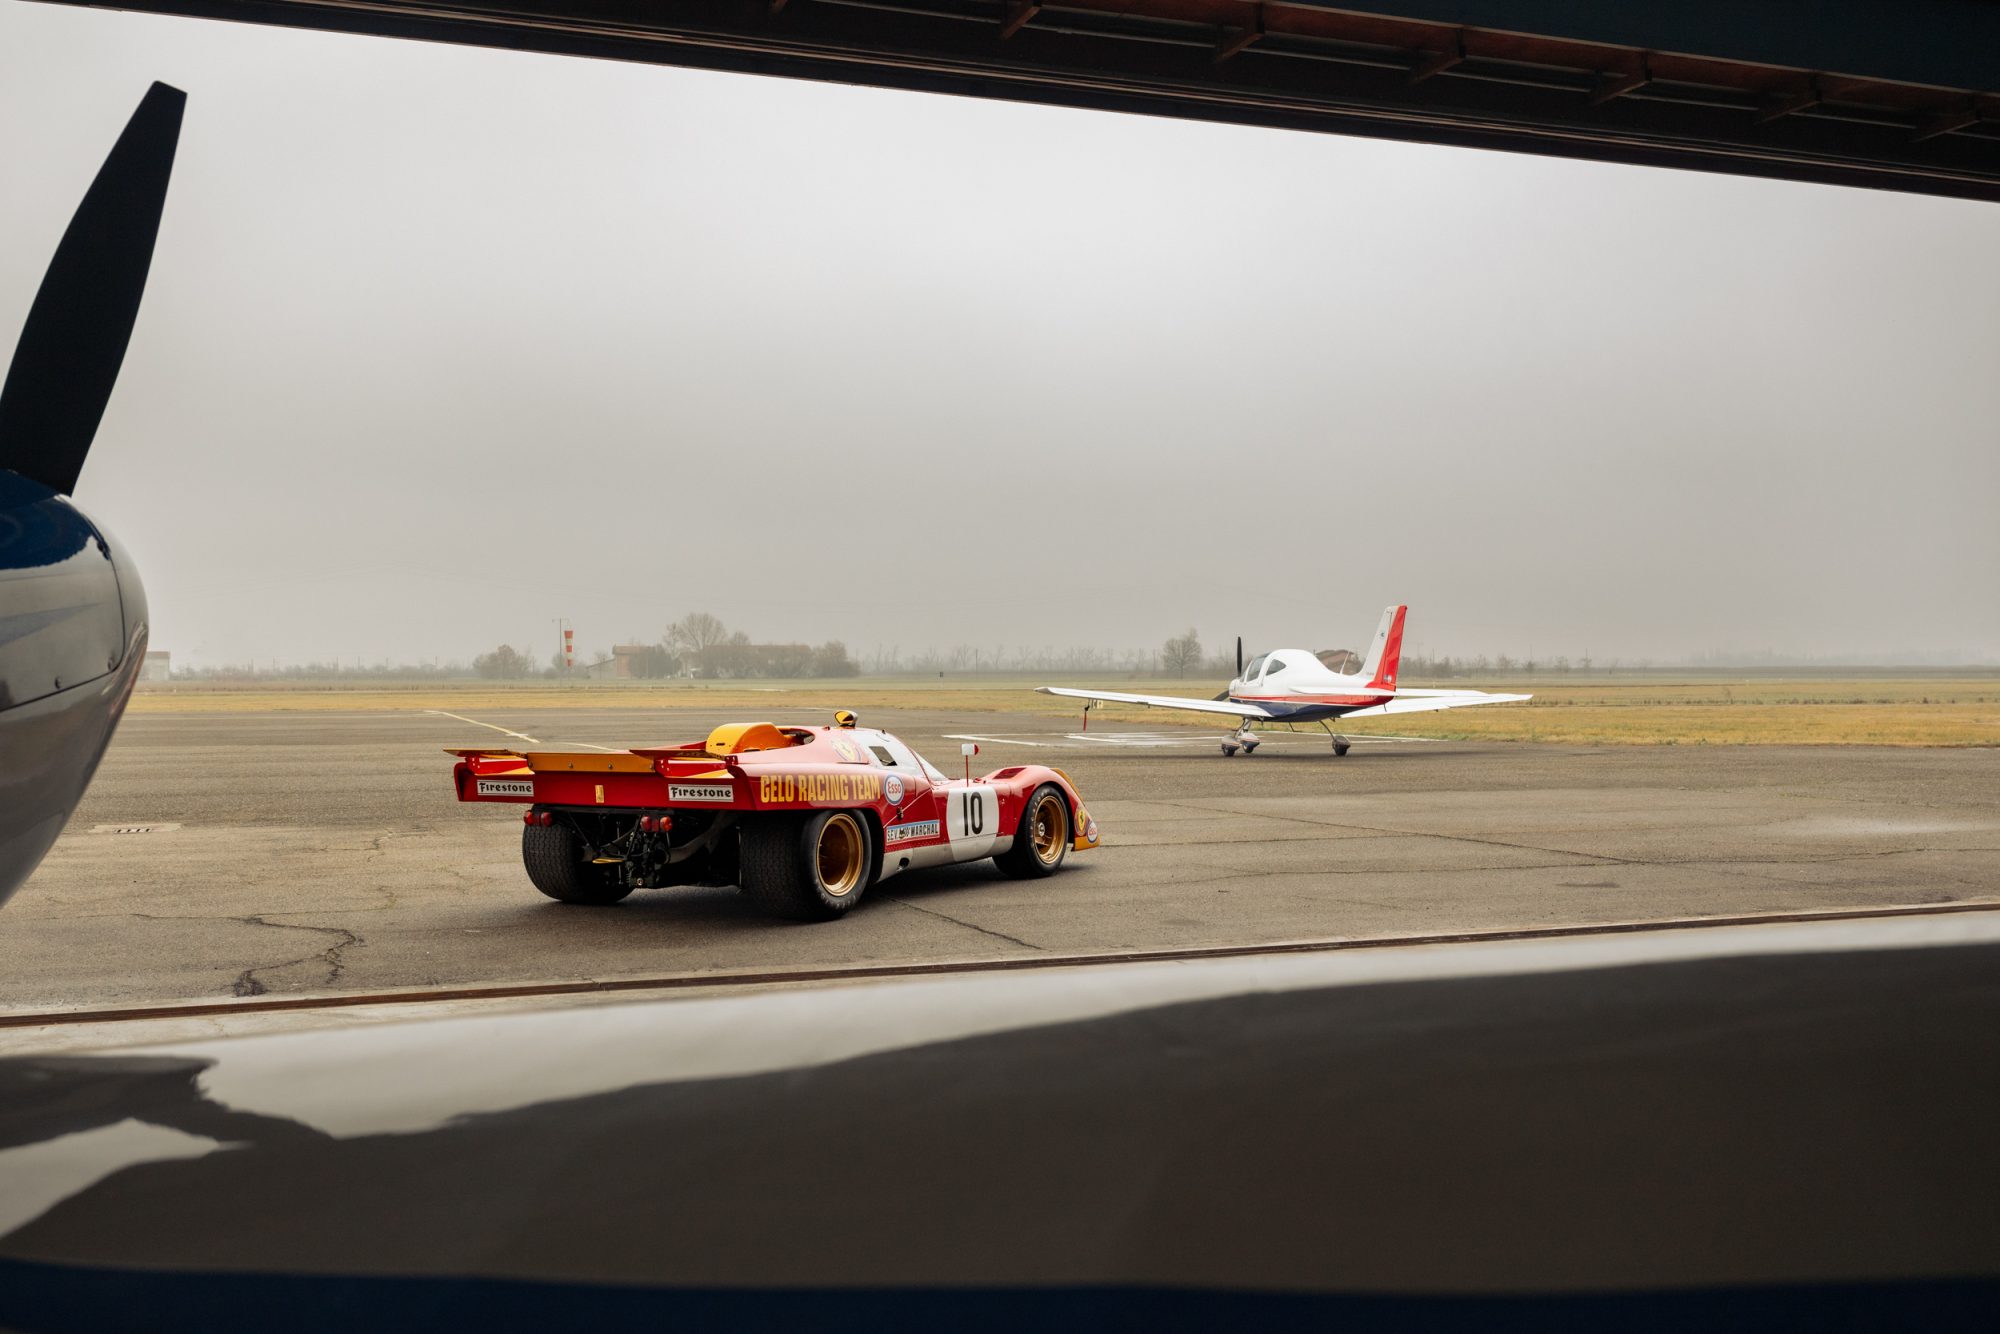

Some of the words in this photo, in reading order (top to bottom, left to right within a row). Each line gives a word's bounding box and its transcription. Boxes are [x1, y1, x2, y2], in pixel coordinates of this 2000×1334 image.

[479, 782, 532, 793] Firestone
[670, 786, 732, 798] Firestone
[761, 775, 795, 803] GELO
[798, 774, 849, 802] RACING
[851, 775, 880, 800] TEAM
[887, 781, 902, 794] Esso
[963, 792, 983, 836] 10
[910, 823, 939, 837] MARCHAL
